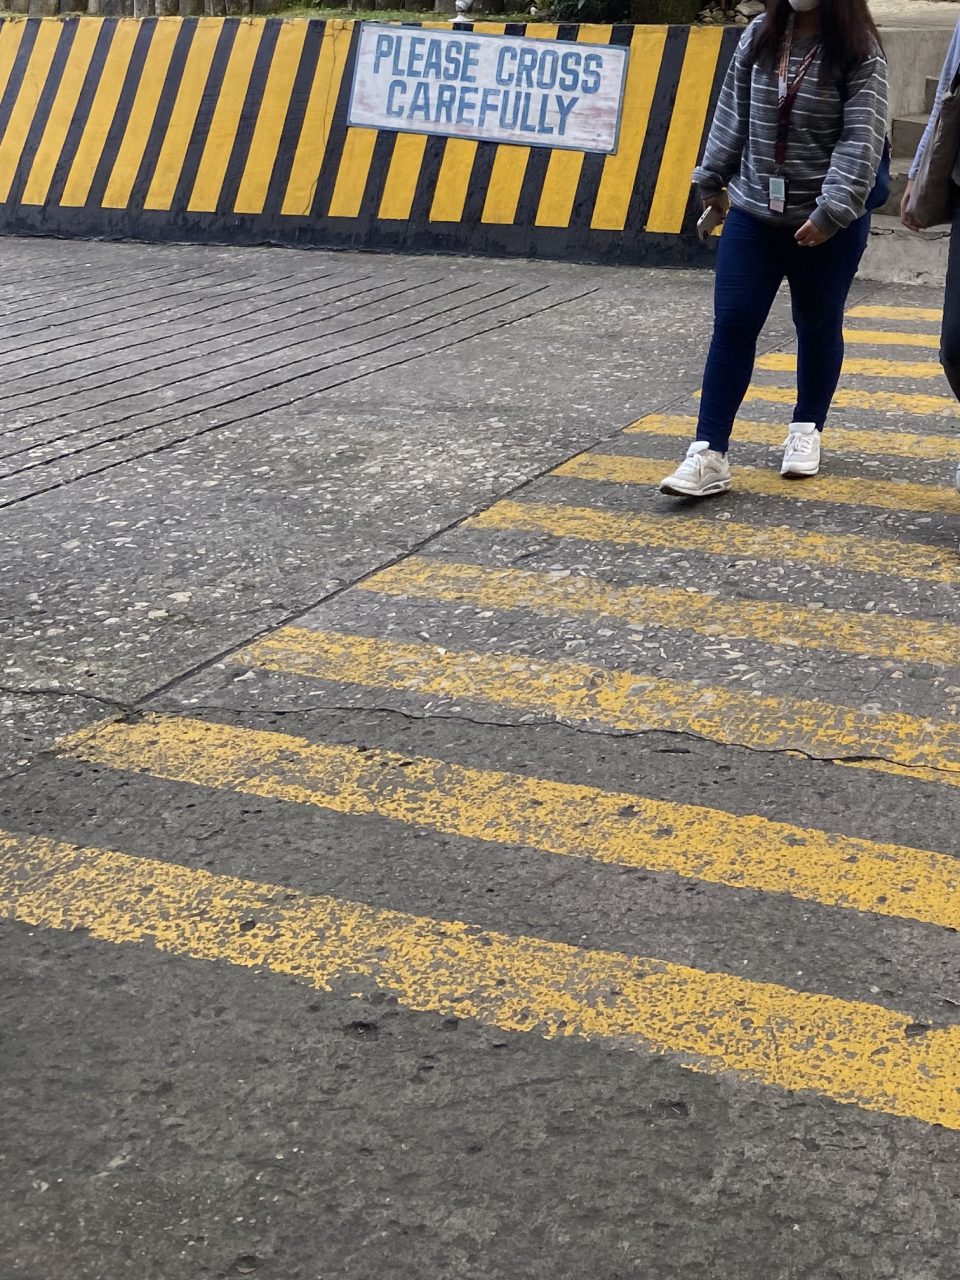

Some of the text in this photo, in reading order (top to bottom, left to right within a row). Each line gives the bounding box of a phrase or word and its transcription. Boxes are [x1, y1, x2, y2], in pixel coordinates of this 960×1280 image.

[373, 33, 603, 95] PLEASE CROSS
[386, 79, 580, 136] CAREFULLY
